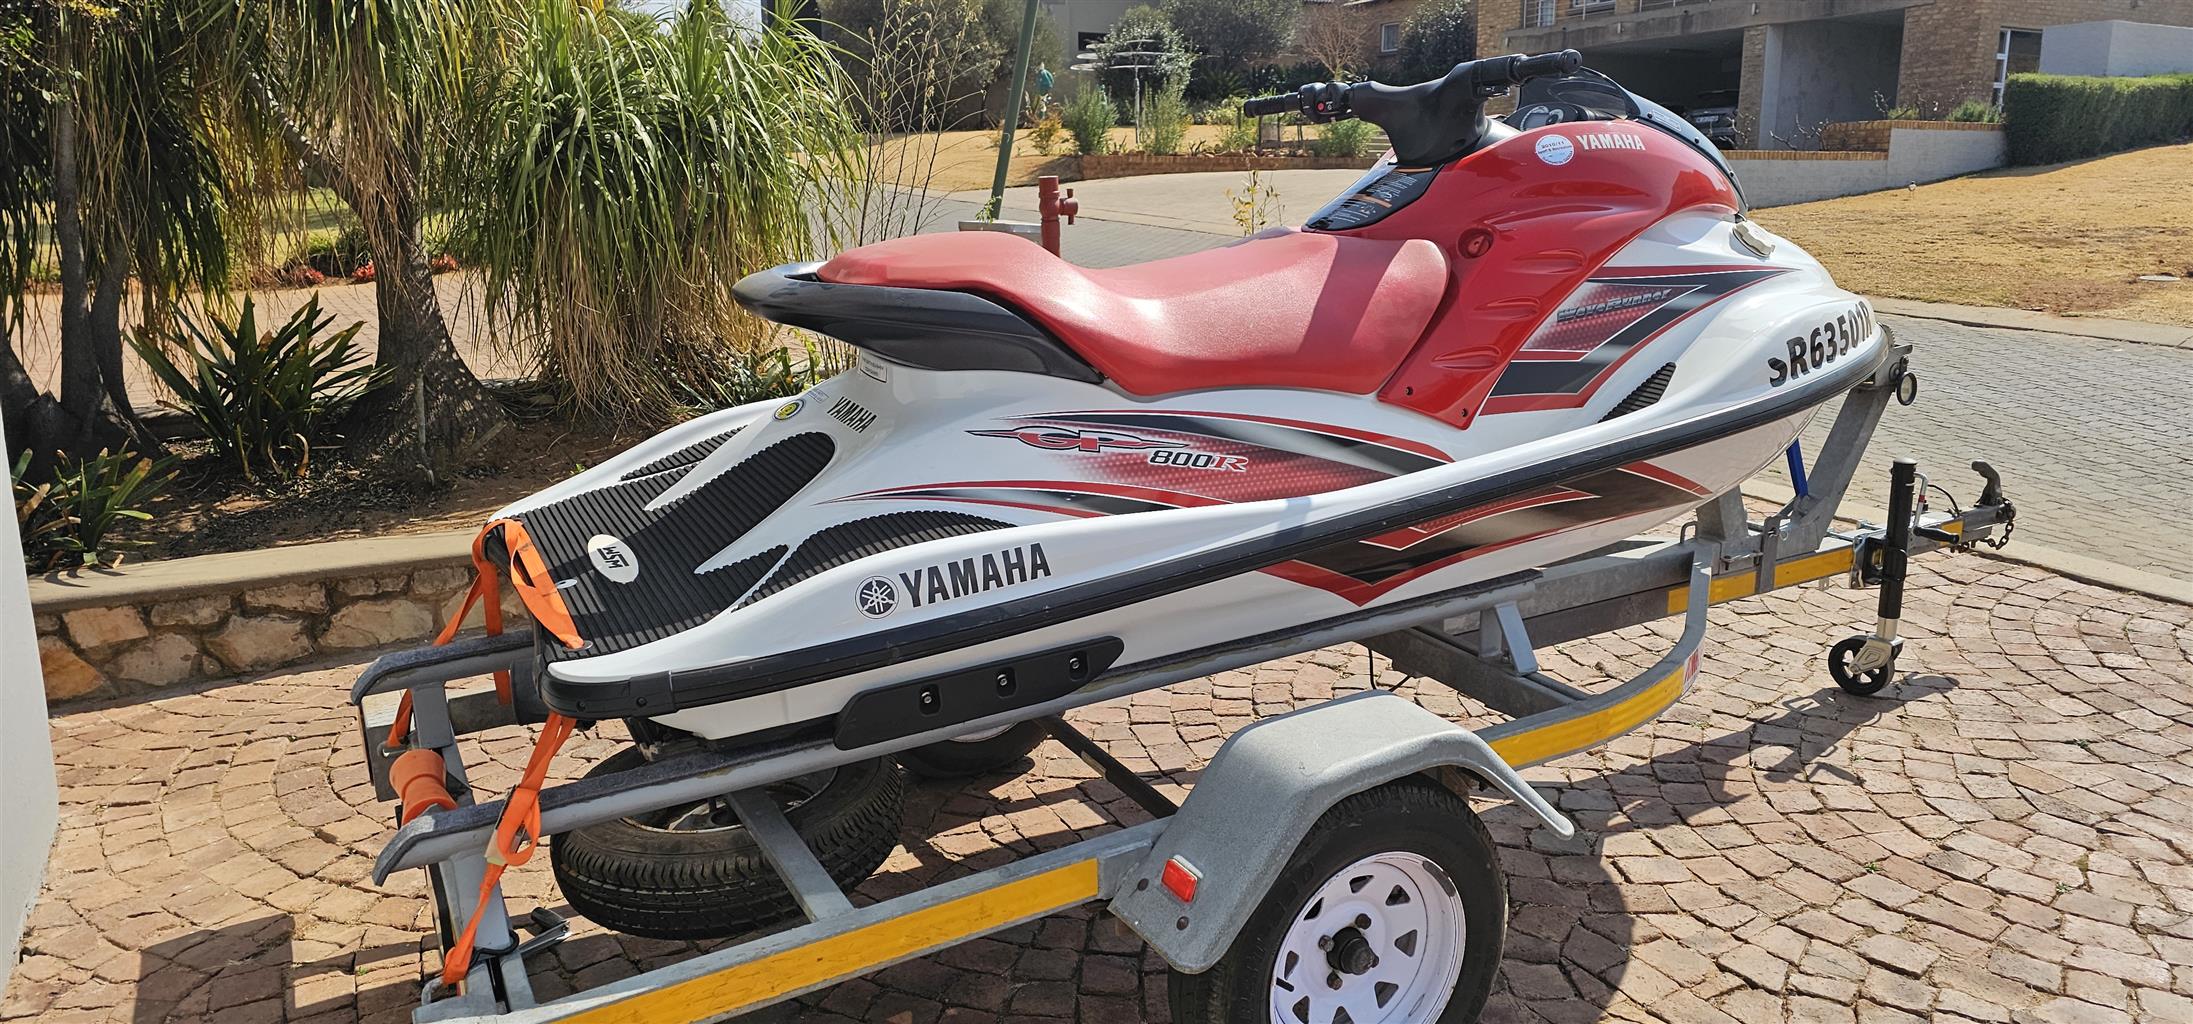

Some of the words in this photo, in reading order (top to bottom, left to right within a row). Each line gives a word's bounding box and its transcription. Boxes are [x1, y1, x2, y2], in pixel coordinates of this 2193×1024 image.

[1576, 134, 1646, 150] YAMAHA
[1767, 300, 1873, 388] SR63501R
[827, 396, 878, 434] YAMAHA
[1148, 449, 1249, 472] 800R
[898, 542, 1052, 608] YAMAHA
